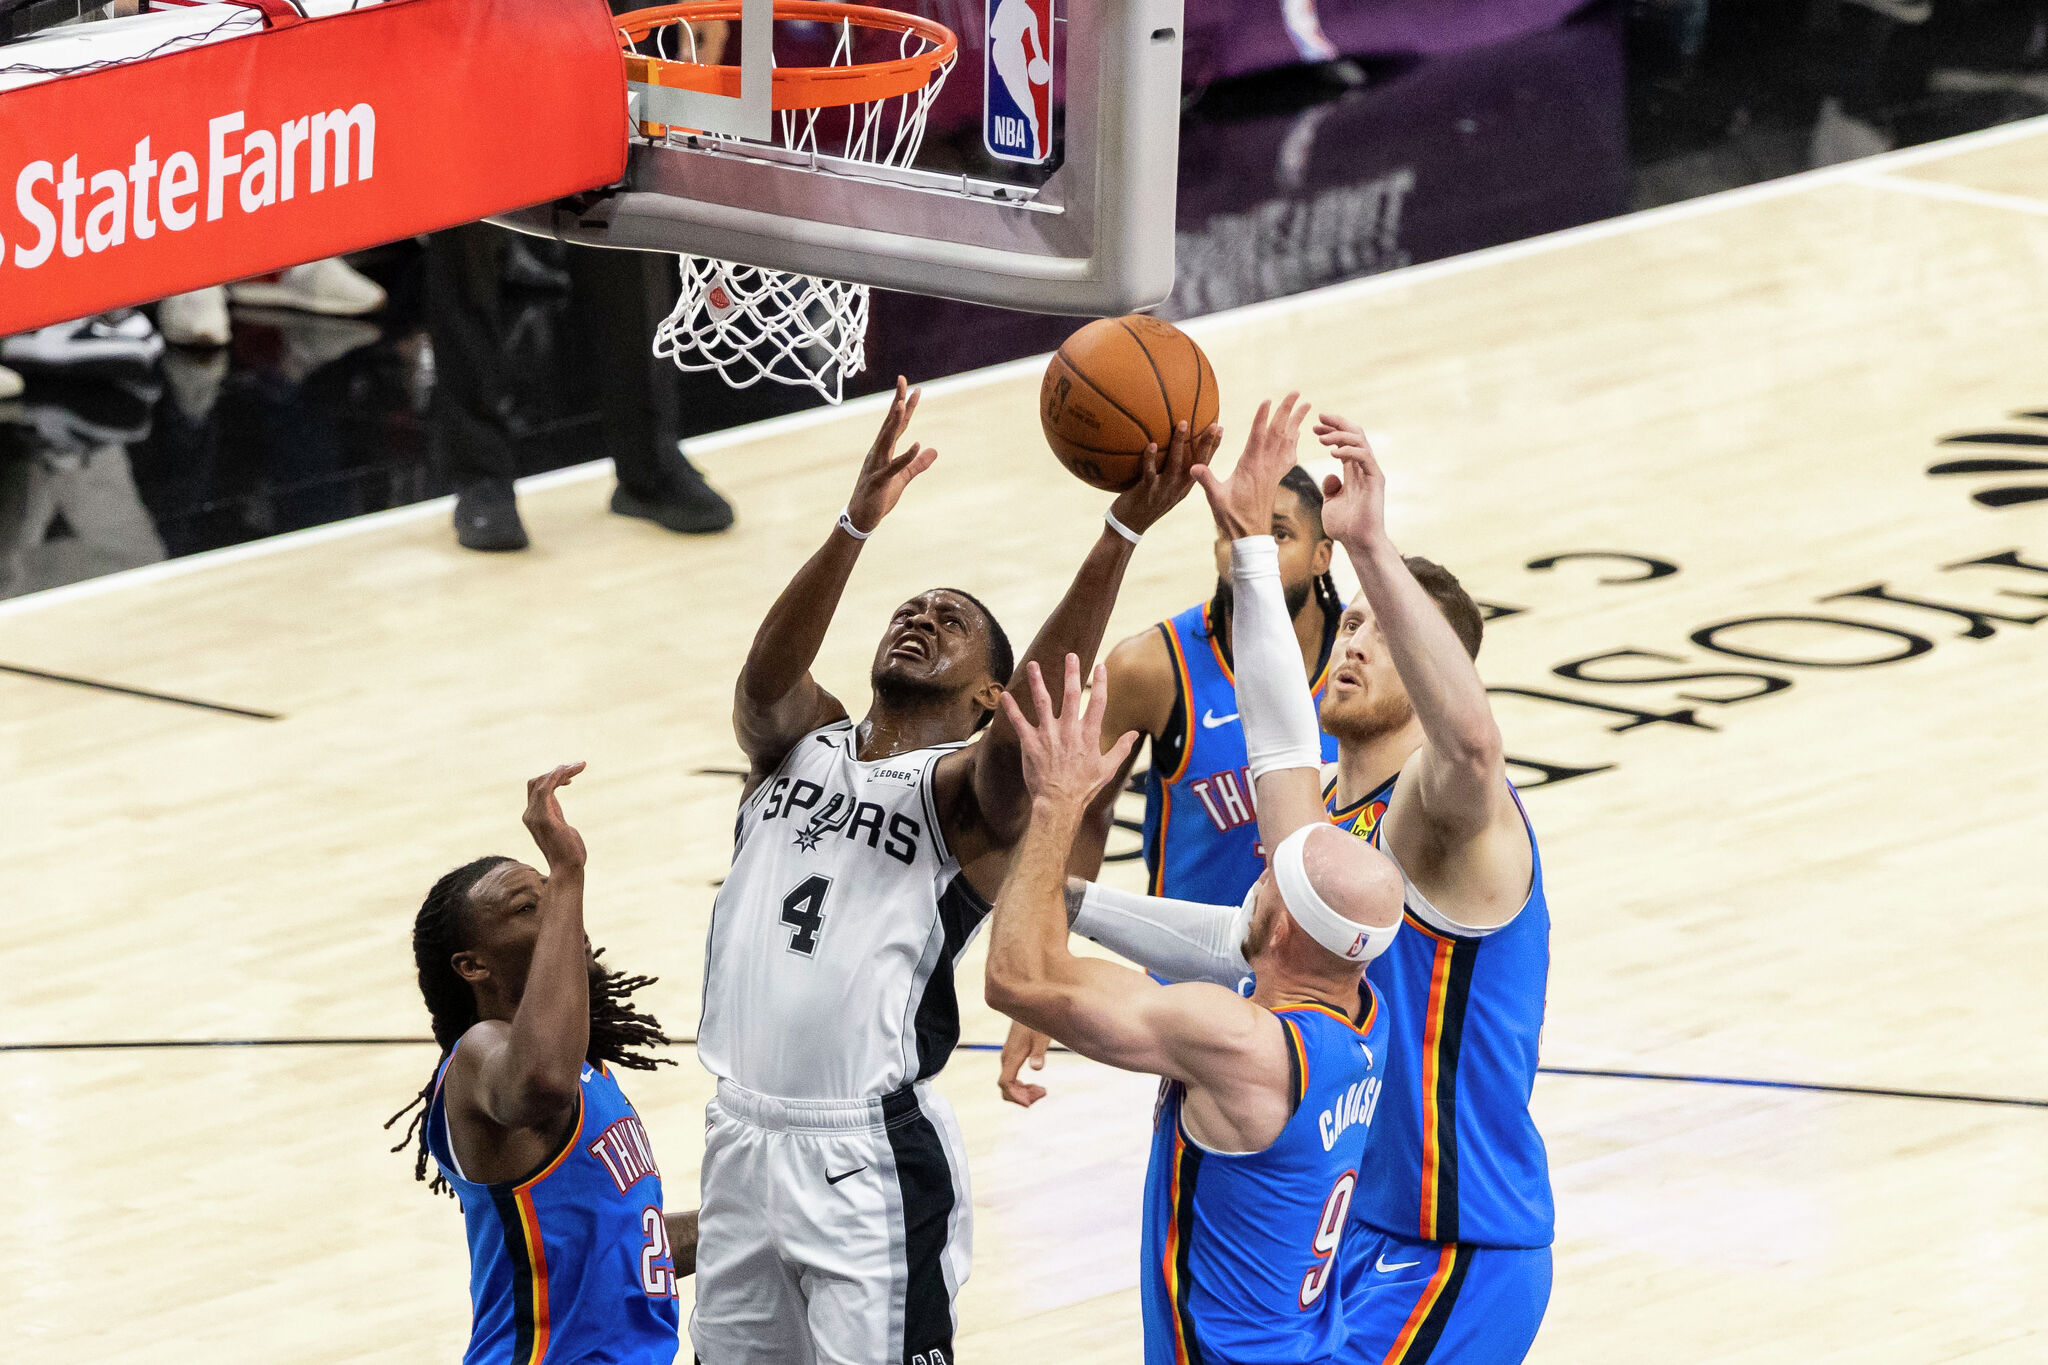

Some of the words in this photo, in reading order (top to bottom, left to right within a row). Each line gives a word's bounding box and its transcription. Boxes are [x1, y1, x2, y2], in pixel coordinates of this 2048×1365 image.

[995, 115, 1026, 149] NBA
[874, 769, 912, 781] LEDGER
[762, 778, 920, 866] SPURS
[779, 872, 834, 959] 4
[1299, 1169, 1357, 1311] 9
